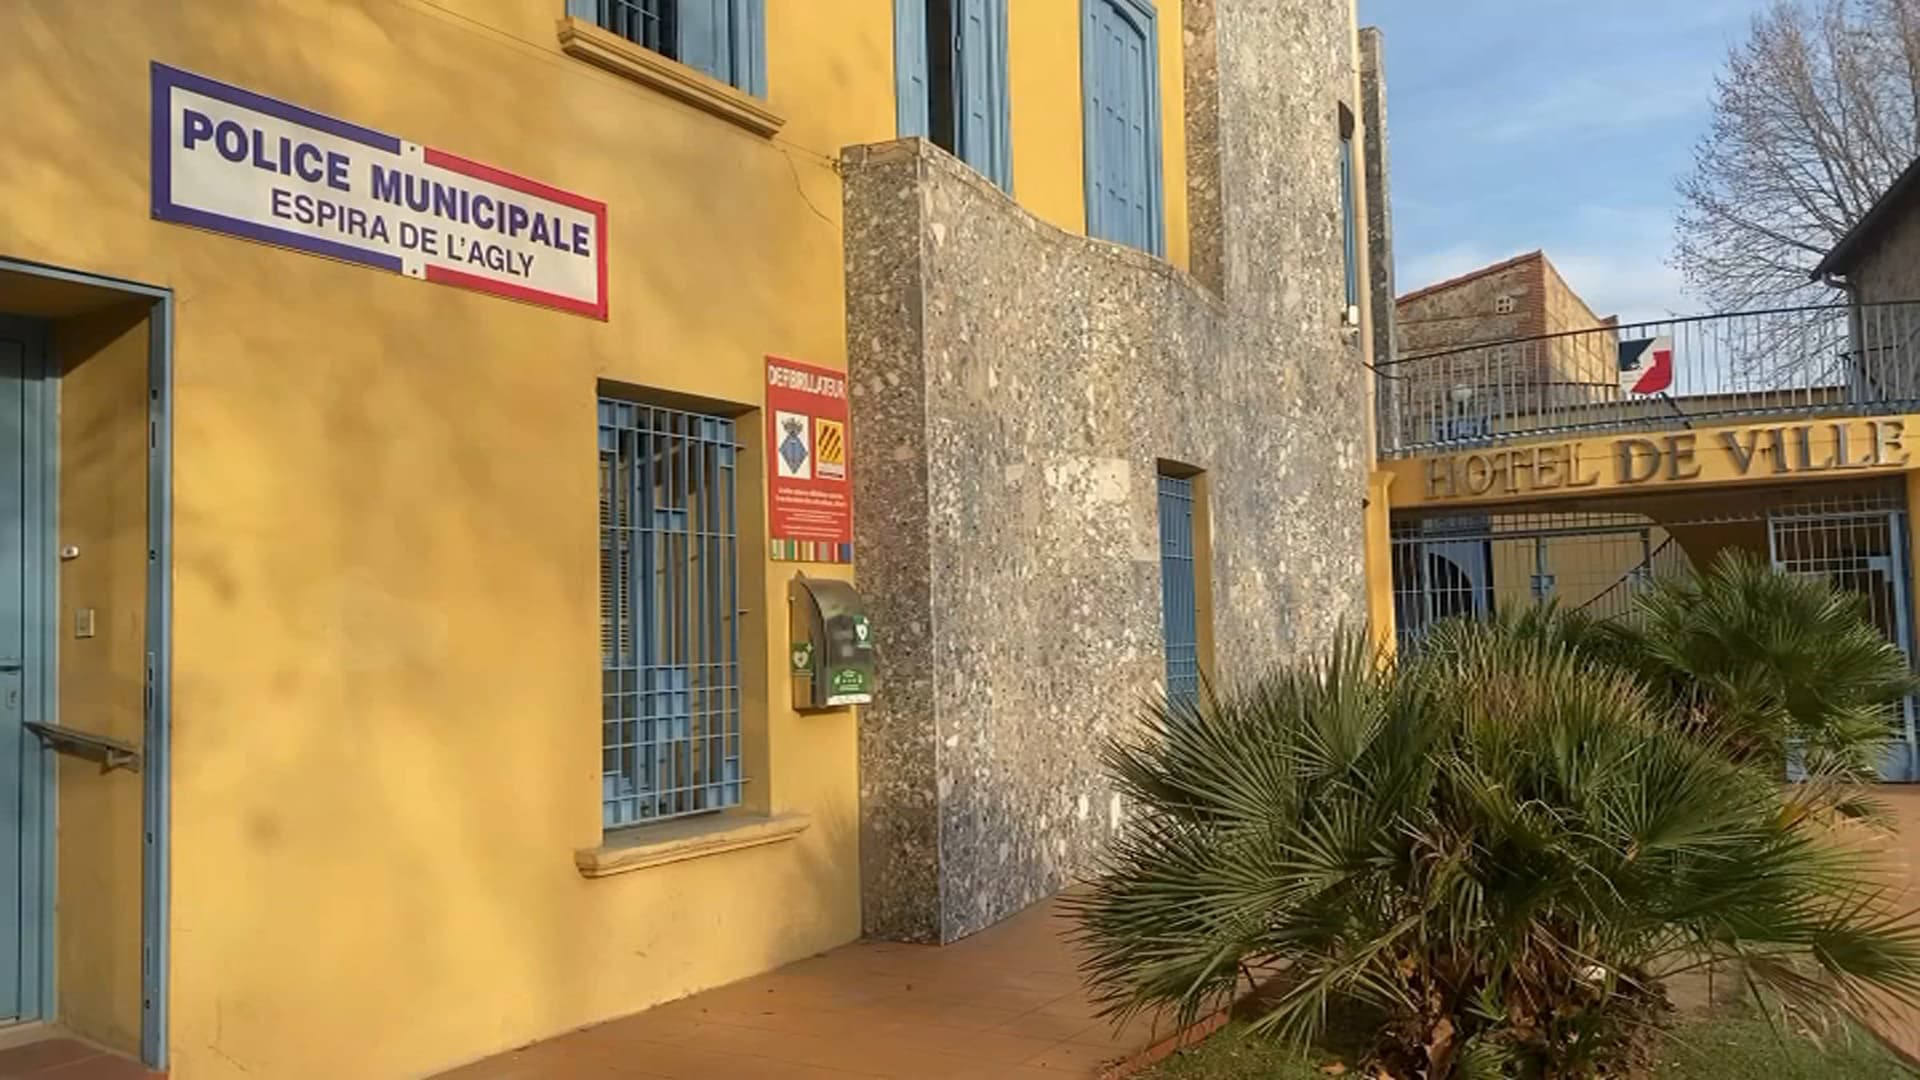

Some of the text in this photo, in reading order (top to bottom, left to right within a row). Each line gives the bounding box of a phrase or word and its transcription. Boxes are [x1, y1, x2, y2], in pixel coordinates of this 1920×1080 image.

[182, 108, 591, 257] POLICE MUNICIPALE
[271, 188, 534, 278] ESPIRA DE L'AGLY
[1424, 421, 1910, 500] HOTEL DE VILLE
